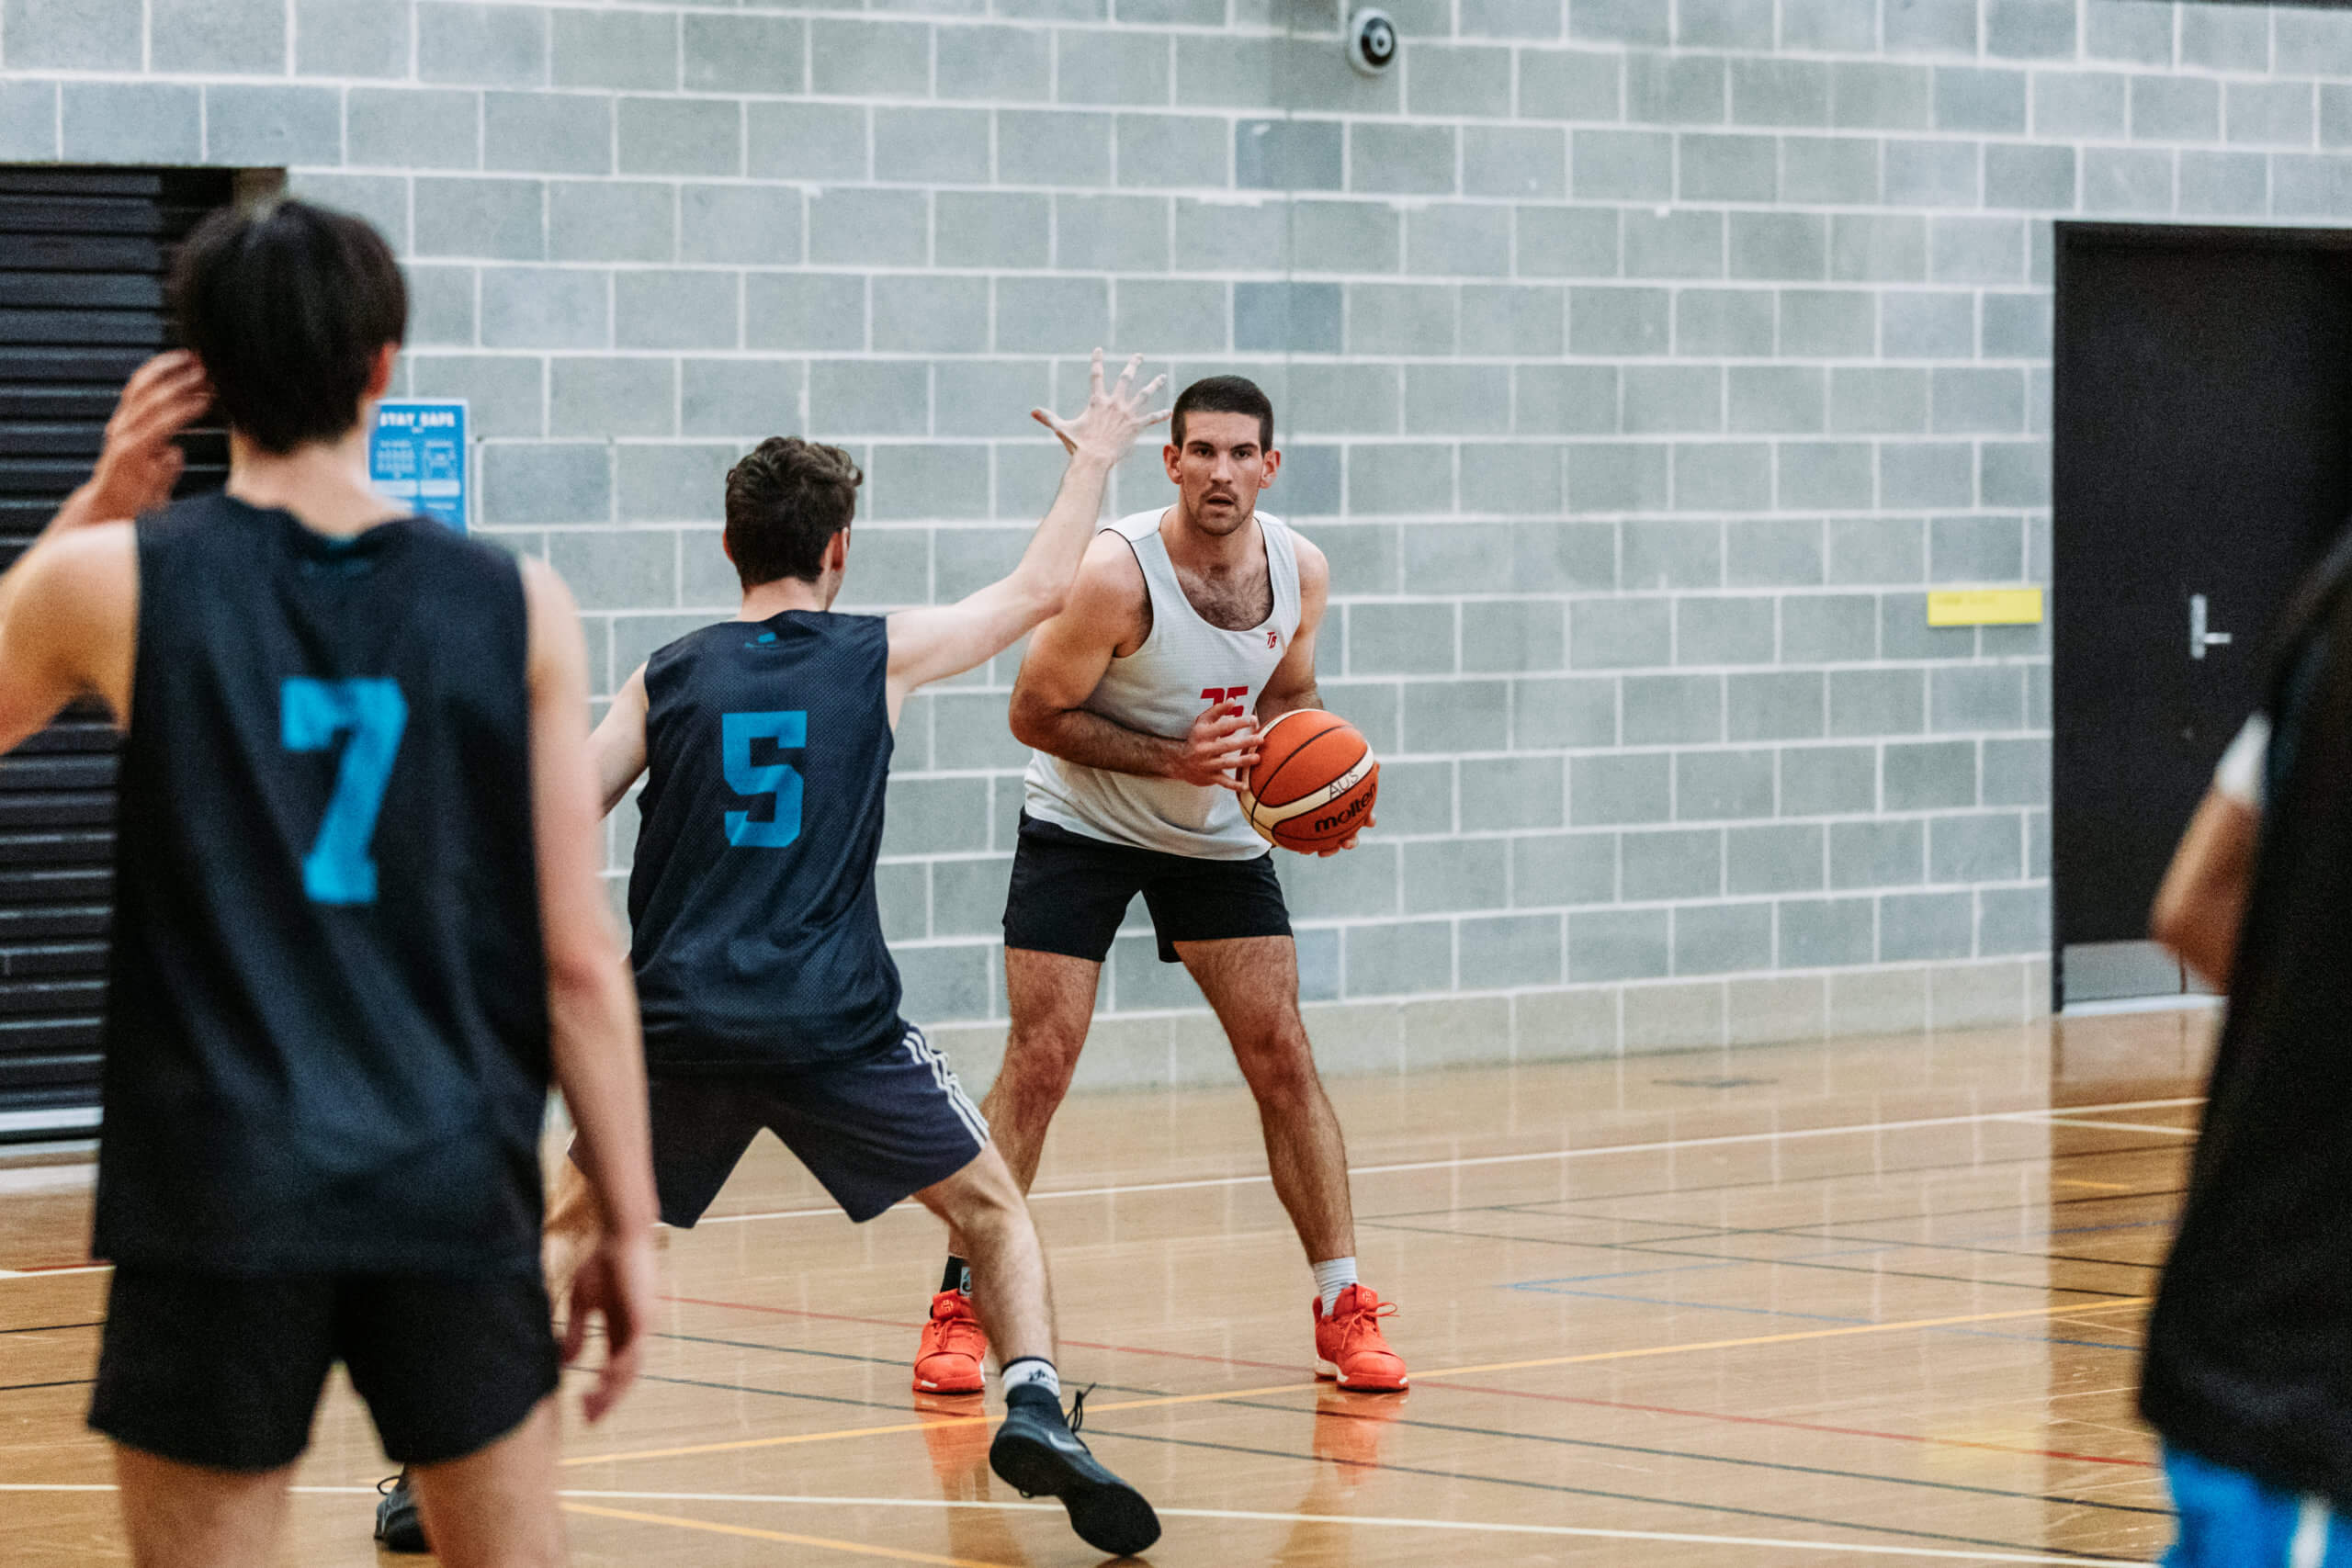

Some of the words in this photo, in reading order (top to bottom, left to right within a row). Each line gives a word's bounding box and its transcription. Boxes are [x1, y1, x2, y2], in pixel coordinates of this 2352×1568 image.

[281, 677, 407, 904] 7
[722, 710, 807, 848] 5
[1315, 783, 1376, 832] molten
[1329, 773, 1359, 802] AUS
